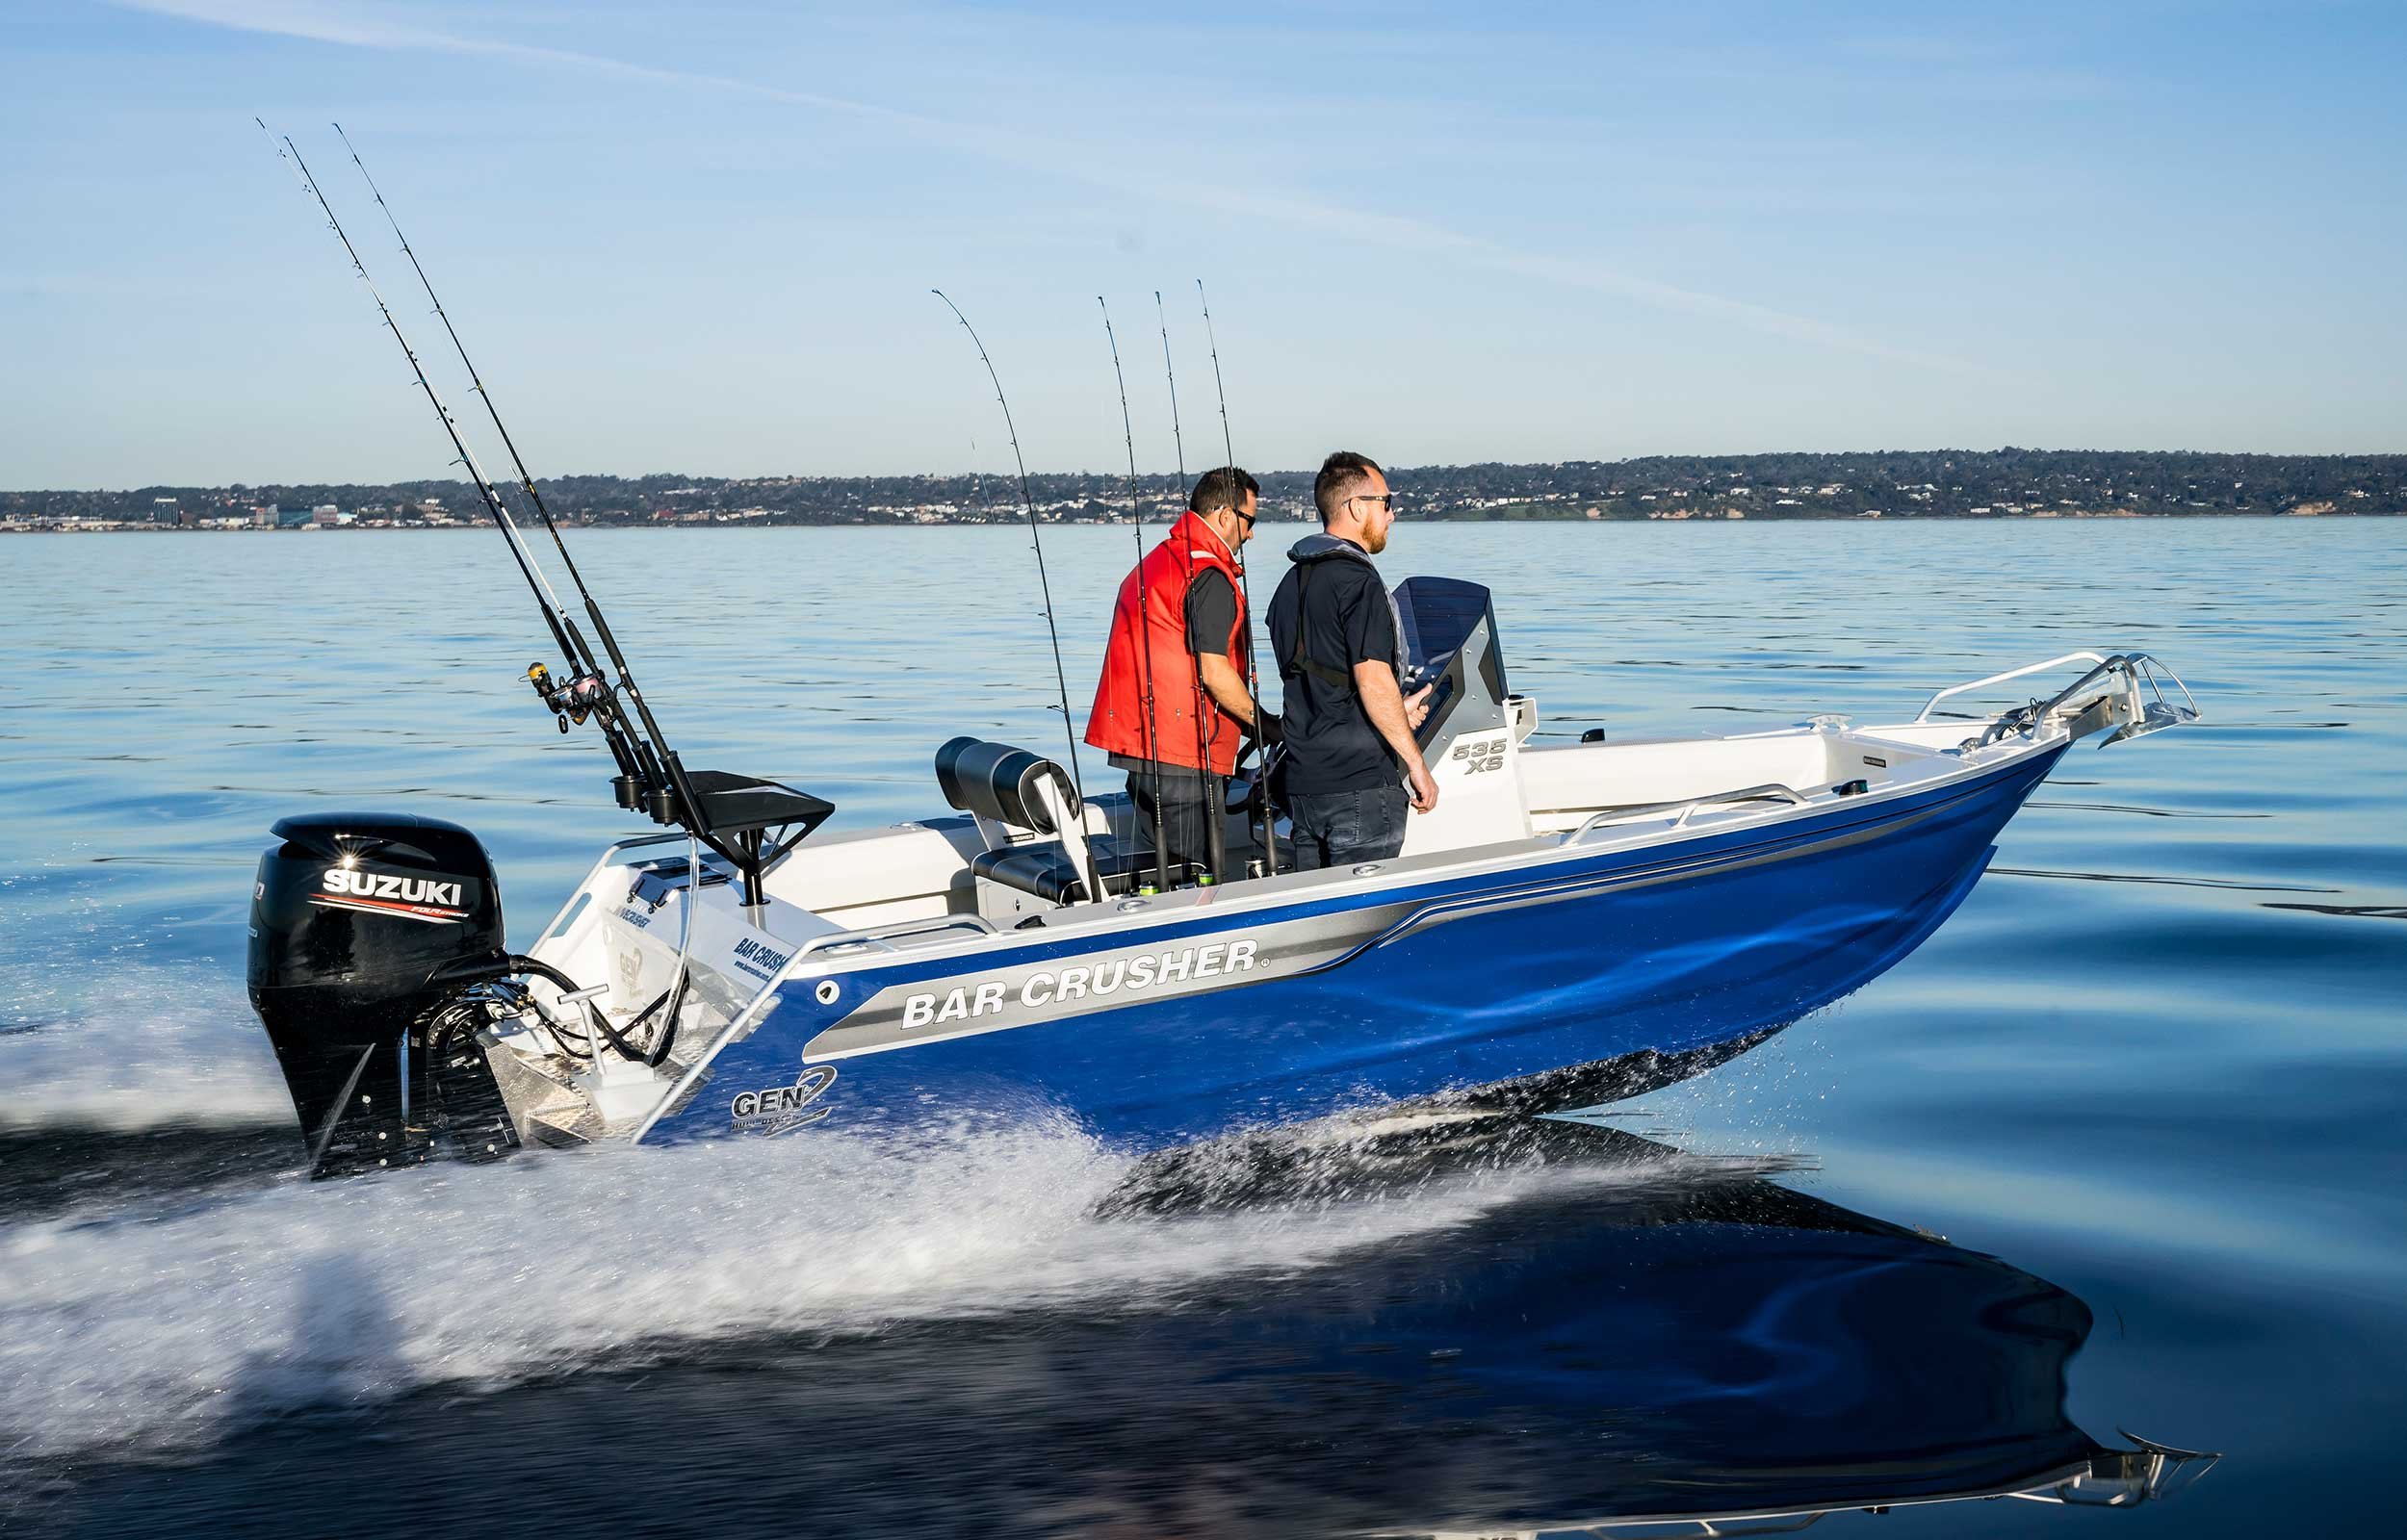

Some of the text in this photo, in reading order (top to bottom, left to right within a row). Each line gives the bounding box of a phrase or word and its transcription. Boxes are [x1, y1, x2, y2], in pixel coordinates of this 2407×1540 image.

[1452, 738, 1507, 760] 535
[1464, 755, 1504, 775] XS
[323, 868, 462, 906] SUZUKI
[734, 937, 760, 959] BAR
[901, 980, 1006, 1030] BAR
